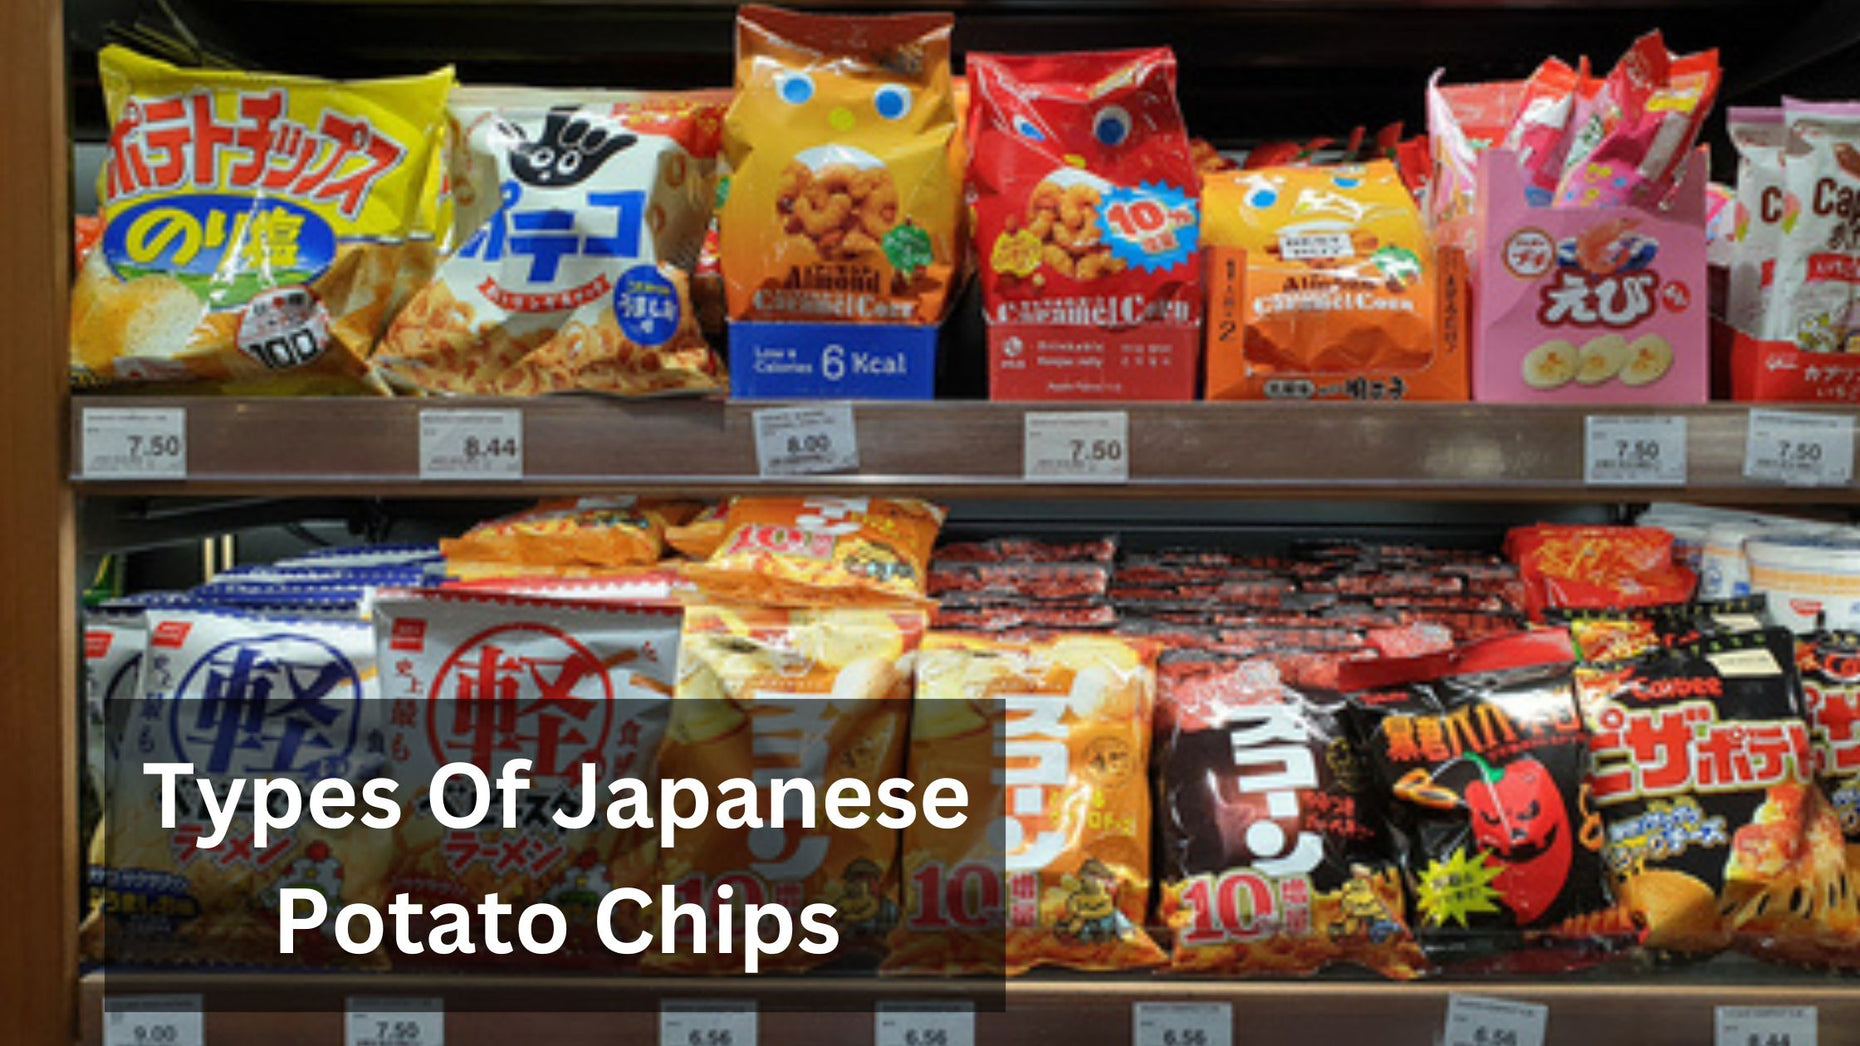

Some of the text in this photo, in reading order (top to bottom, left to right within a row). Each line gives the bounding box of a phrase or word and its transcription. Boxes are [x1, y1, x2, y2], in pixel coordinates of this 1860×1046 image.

[105, 88, 408, 220] ポテトチップス
[1812, 177, 1860, 218] Ca
[124, 205, 305, 272] のり塩
[1545, 271, 1657, 324] えび
[822, 344, 845, 381] 6
[852, 352, 907, 374] Kcal
[126, 434, 181, 457] 7.50
[464, 435, 517, 458] 8.44
[1070, 438, 1122, 461] 7.50
[1631, 675, 1723, 701] Calbee
[444, 831, 565, 872] ラーメン
